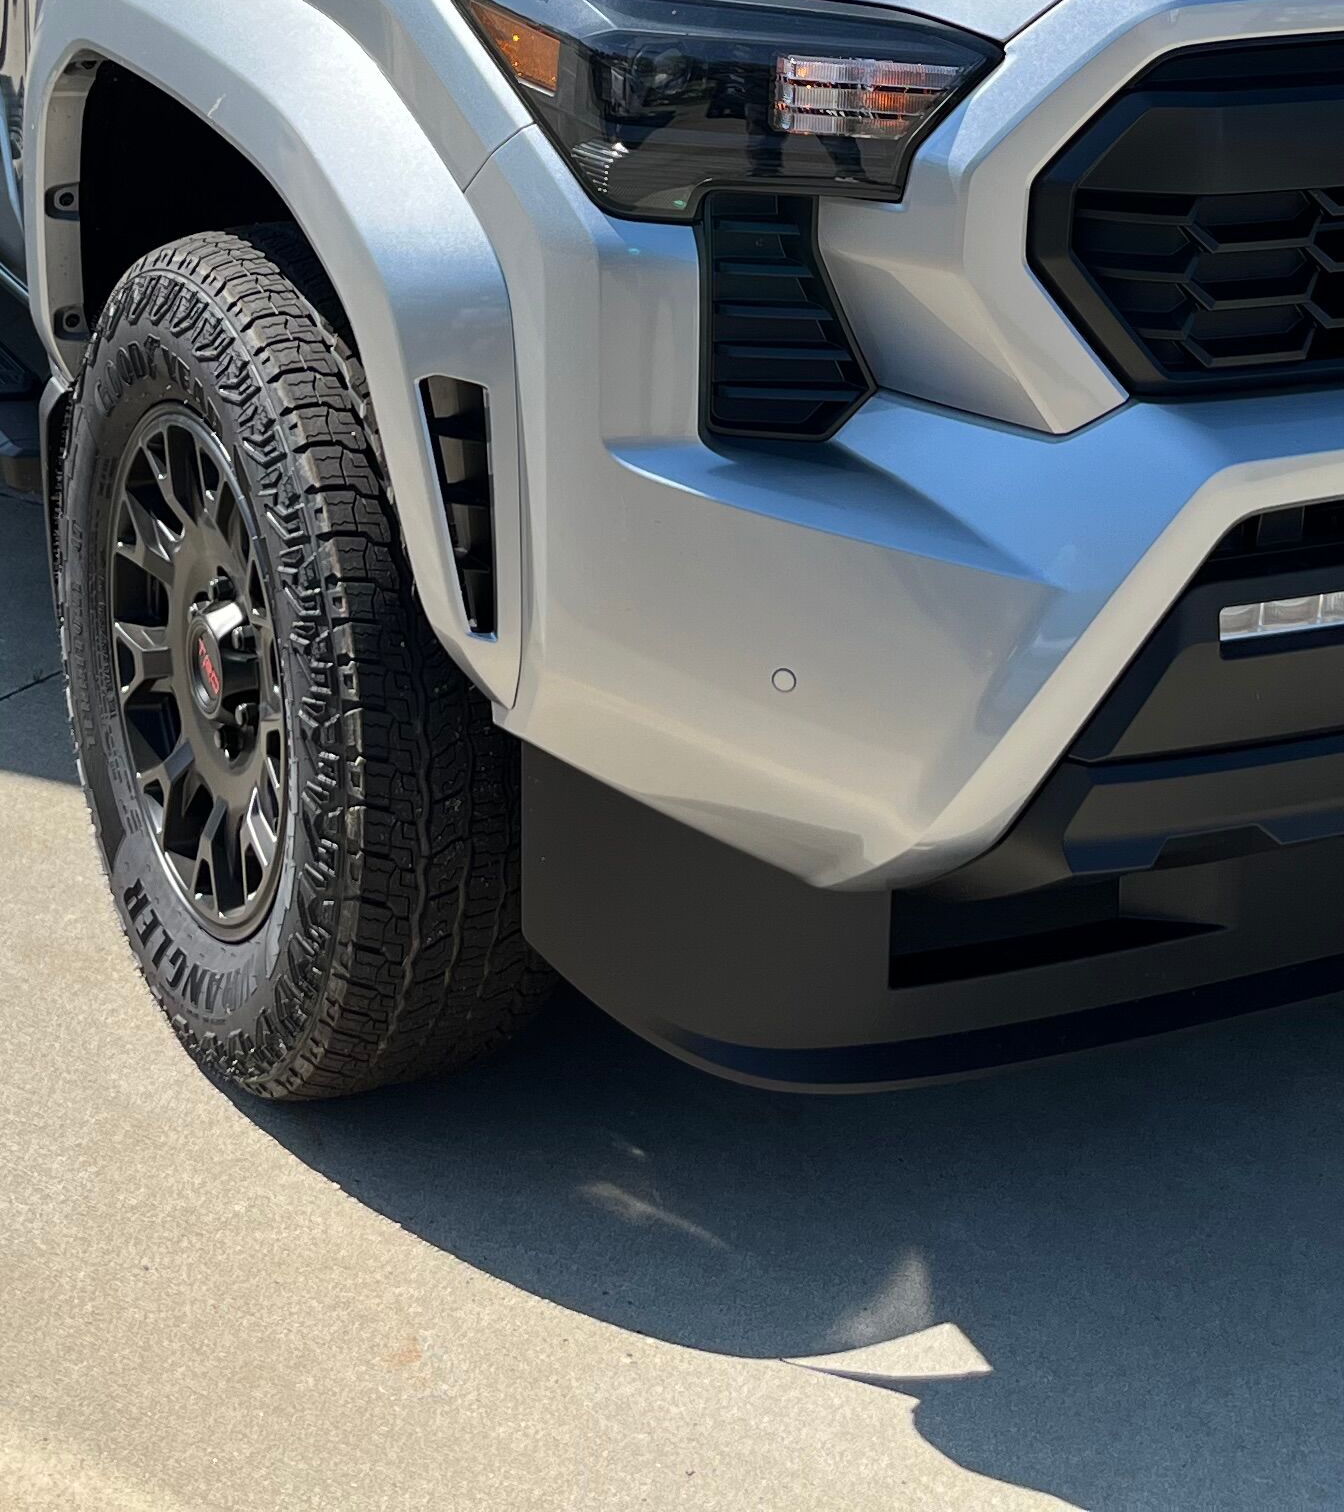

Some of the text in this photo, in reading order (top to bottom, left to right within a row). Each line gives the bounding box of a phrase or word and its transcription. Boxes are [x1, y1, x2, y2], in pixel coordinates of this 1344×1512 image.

[94, 333, 224, 440] GOODYEAR
[198, 637, 221, 695] TRD
[123, 877, 258, 1015] WRANGLER
